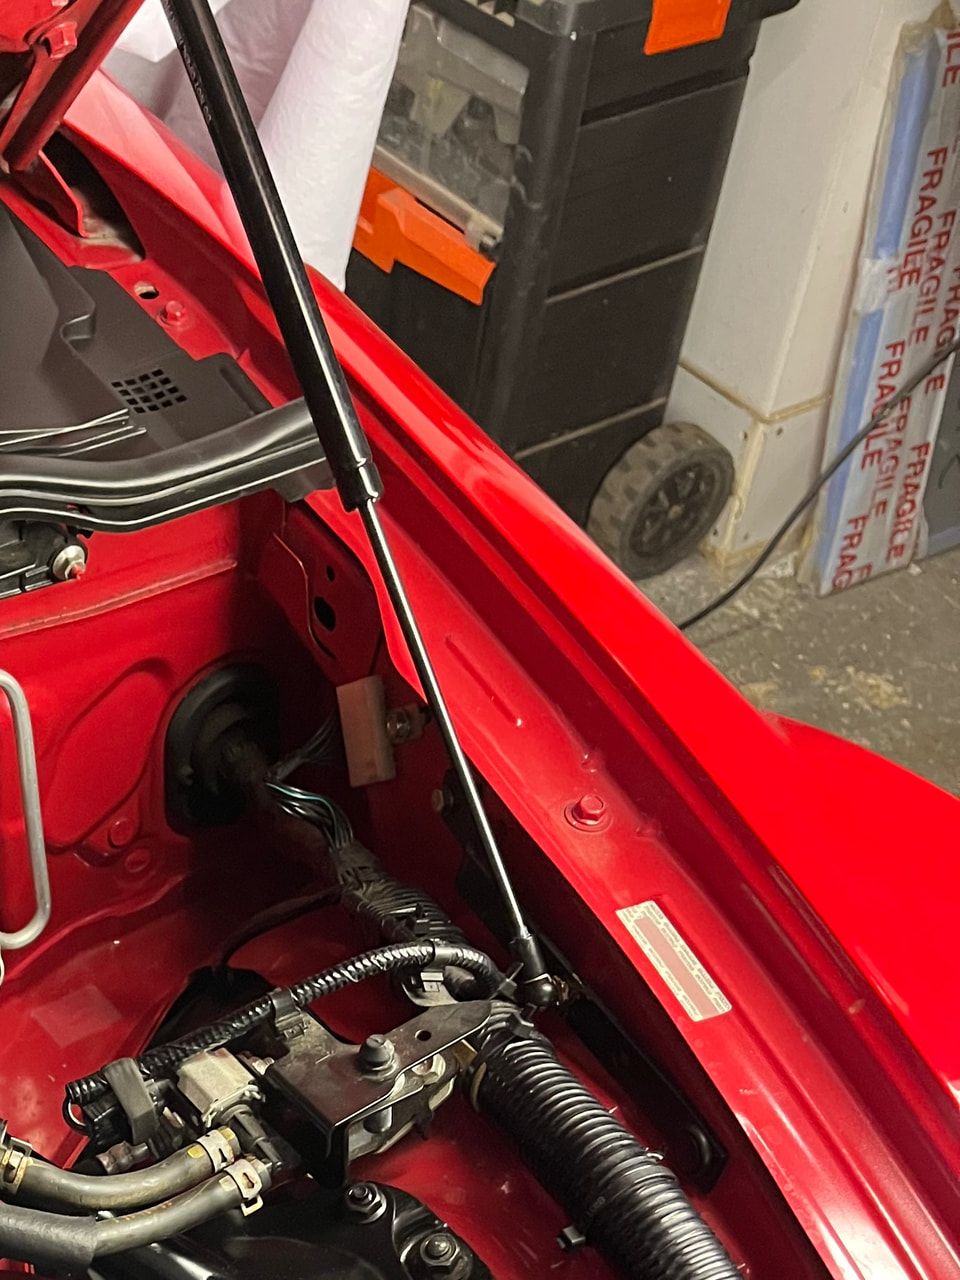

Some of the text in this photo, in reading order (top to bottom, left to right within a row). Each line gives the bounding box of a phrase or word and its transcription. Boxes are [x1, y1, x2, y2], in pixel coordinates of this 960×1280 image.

[898, 146, 949, 290] FRAGILE
[908, 209, 958, 346] FRAGILE
[886, 442, 931, 563] FRAGILE
